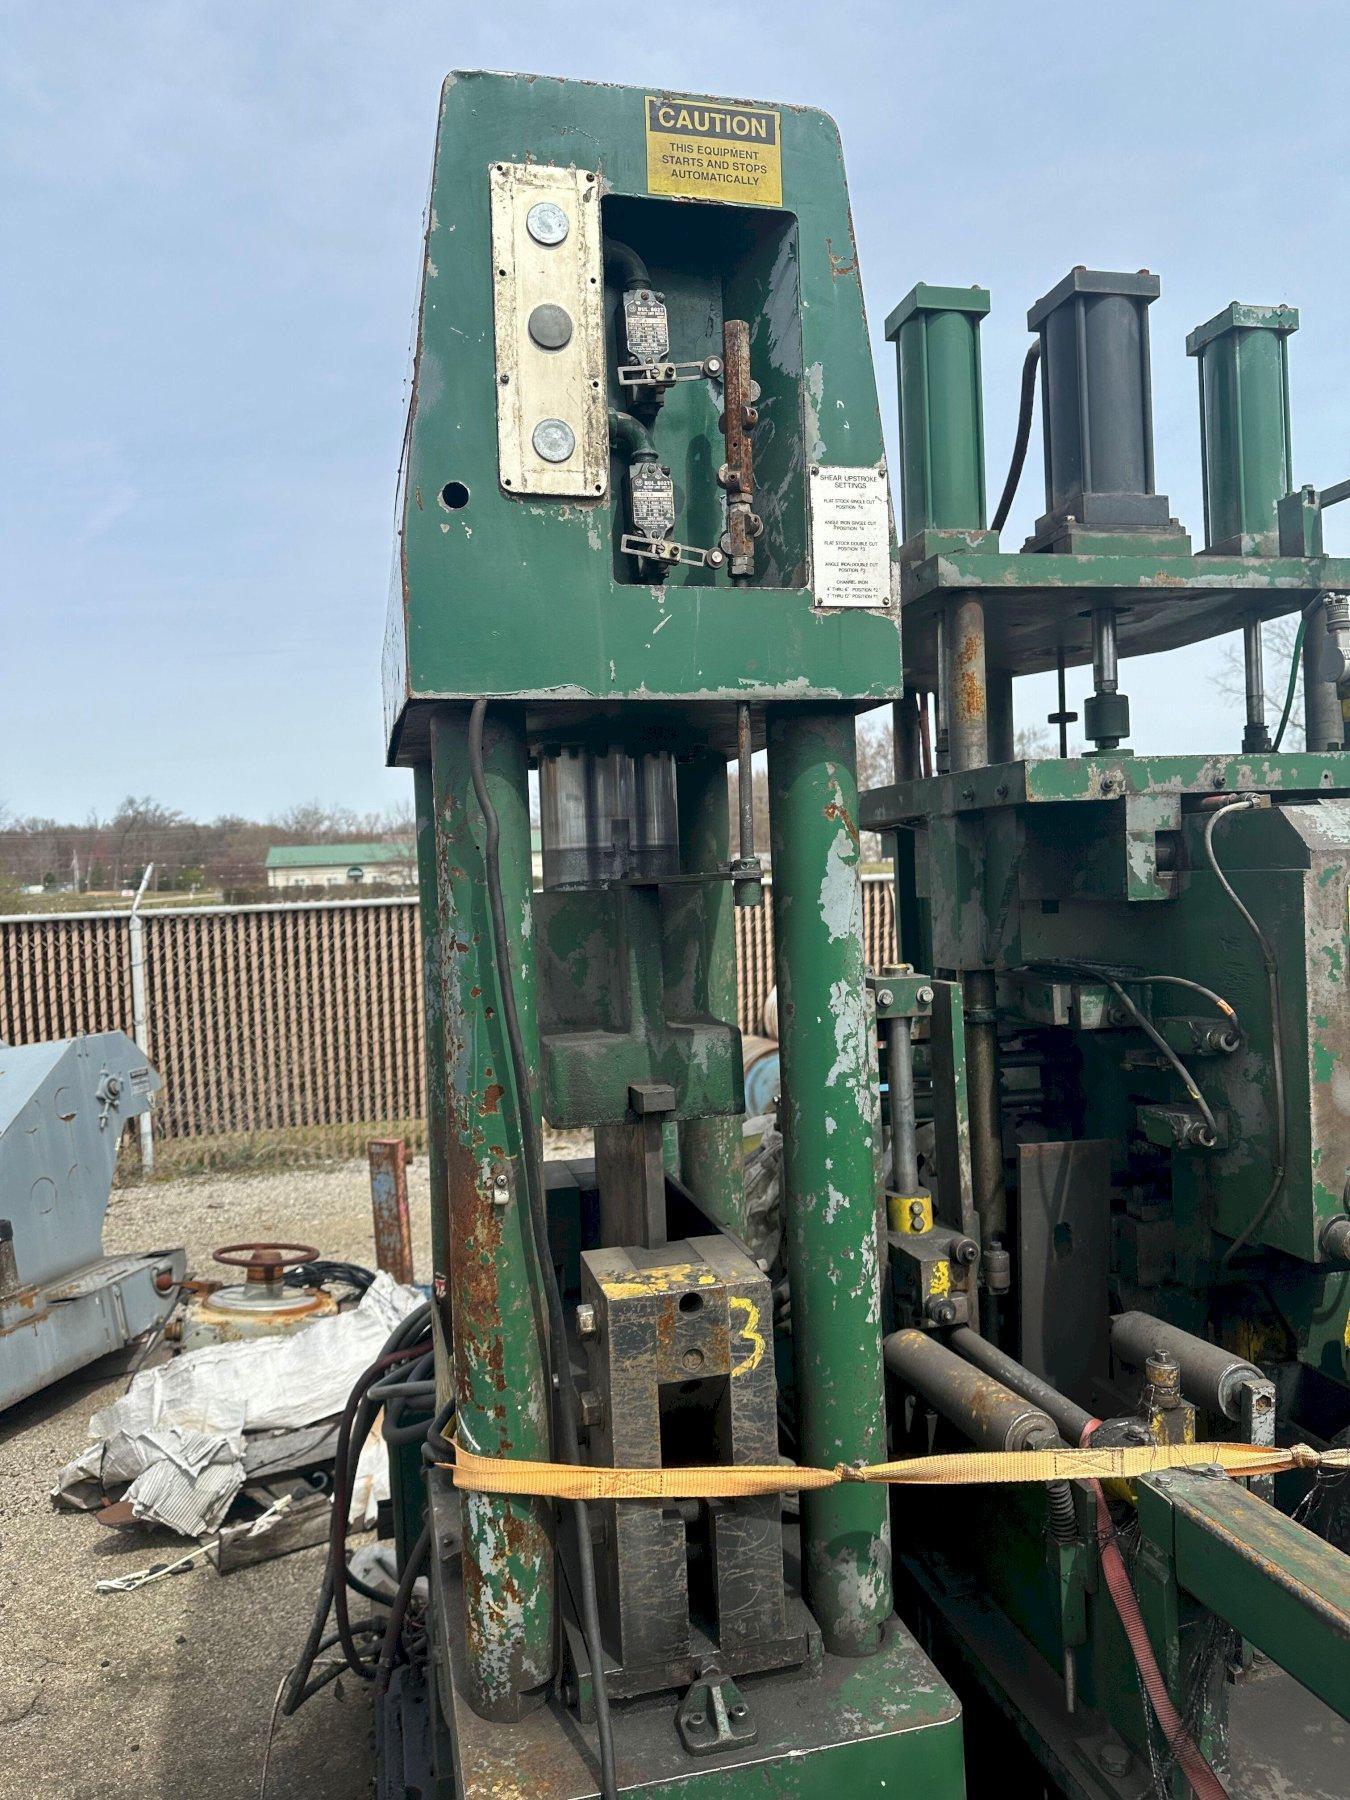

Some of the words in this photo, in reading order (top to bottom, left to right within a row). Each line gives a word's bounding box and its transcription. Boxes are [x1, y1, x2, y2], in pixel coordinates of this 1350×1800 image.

[658, 107, 767, 138] CAUTION
[670, 142, 694, 154] THIS
[697, 145, 760, 161] EQUIPMENT
[662, 154, 704, 168] STARTS
[706, 159, 729, 170] AND
[732, 162, 767, 174] STOPS
[671, 169, 760, 186] AUTOMATICALLY
[844, 475, 878, 483] UPSTROKE
[728, 1296, 766, 1378] 3
